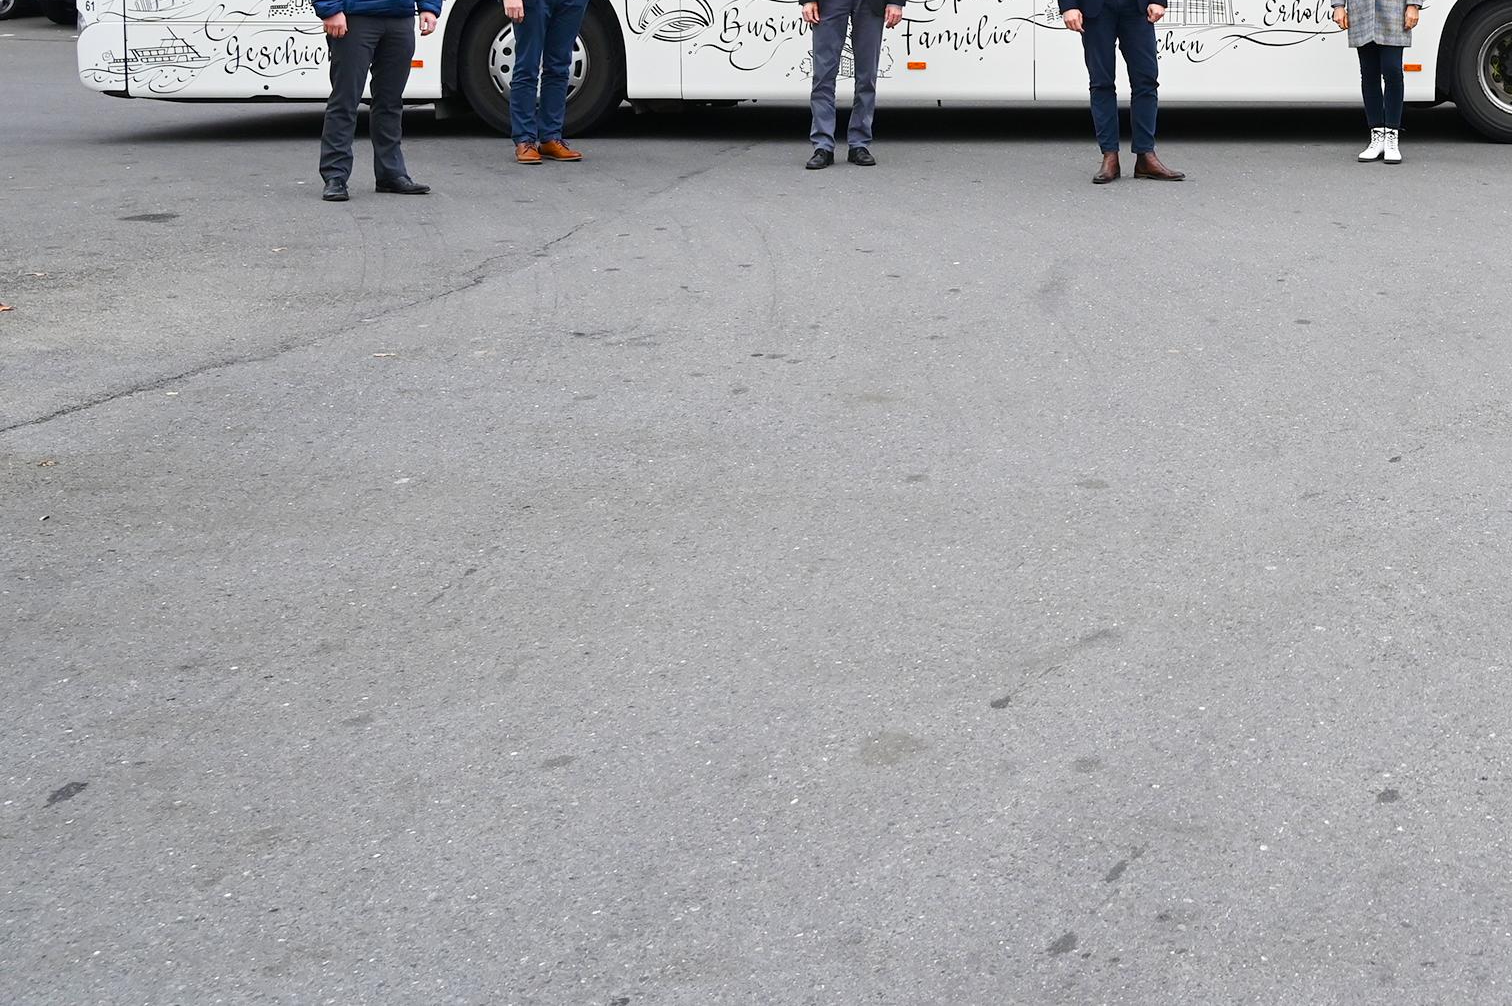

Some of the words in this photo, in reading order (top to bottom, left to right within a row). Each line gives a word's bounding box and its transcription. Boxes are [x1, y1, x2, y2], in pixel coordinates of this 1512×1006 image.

[85, 0, 96, 12] 61
[224, 35, 331, 75] Geschic
[901, 14, 1018, 56] Familie
